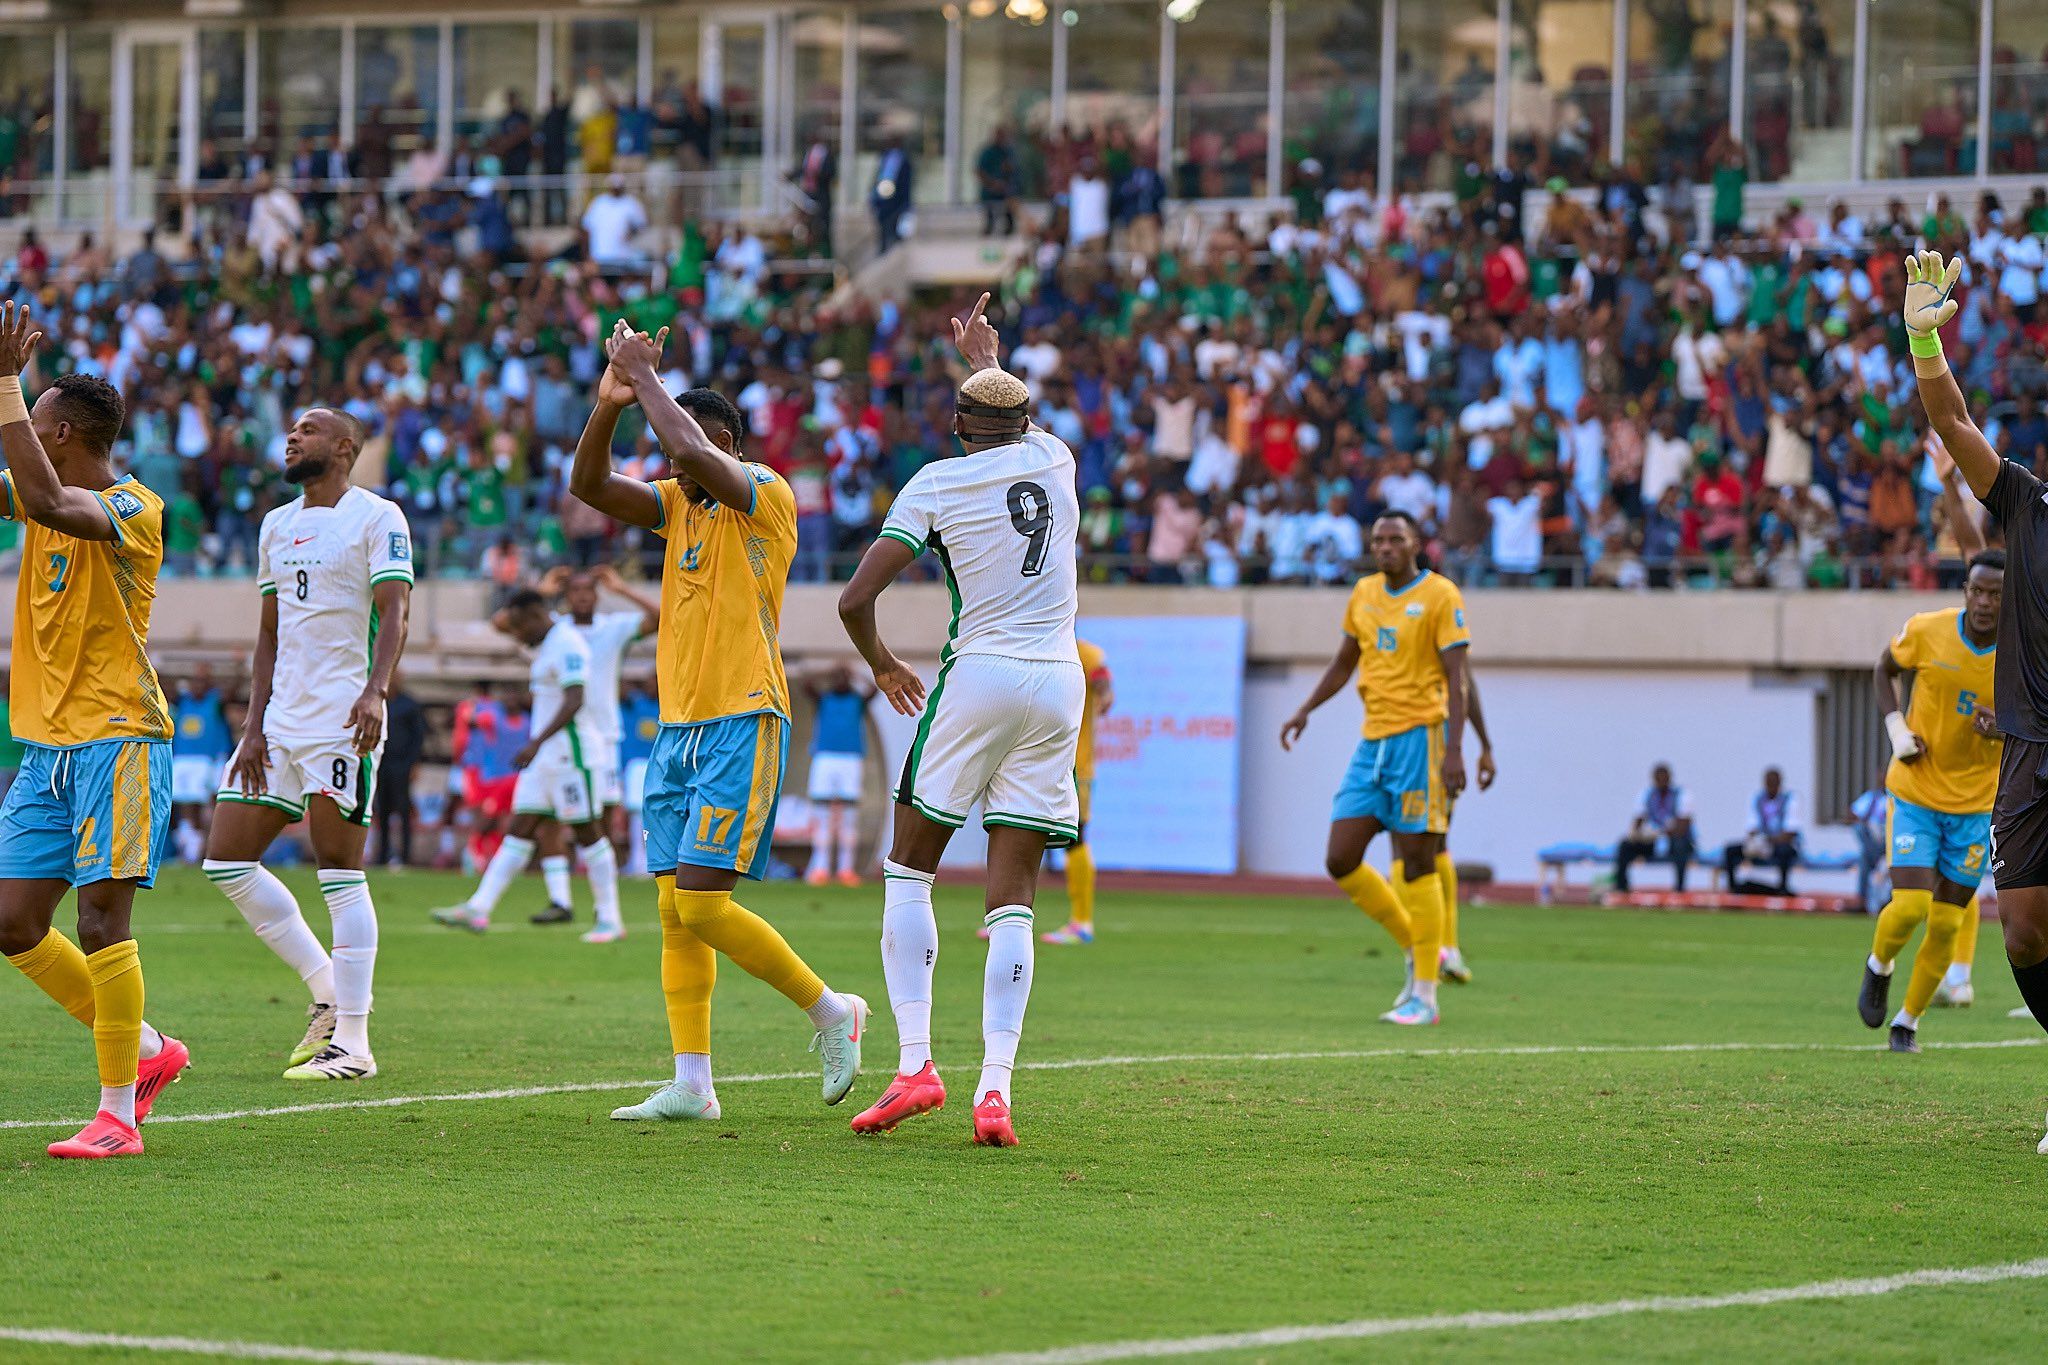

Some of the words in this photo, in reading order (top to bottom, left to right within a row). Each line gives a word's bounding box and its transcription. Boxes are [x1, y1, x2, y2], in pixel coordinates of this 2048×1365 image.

[1006, 481, 1053, 577] 9
[48, 554, 69, 593] 2
[296, 569, 307, 600] 8
[1377, 627, 1397, 651] 15
[1956, 690, 1978, 715] 5
[332, 758, 347, 790] 8
[76, 817, 98, 859] 2
[696, 805, 738, 845] 17
[925, 948, 934, 966] NFF
[1012, 963, 1023, 982] NFF
